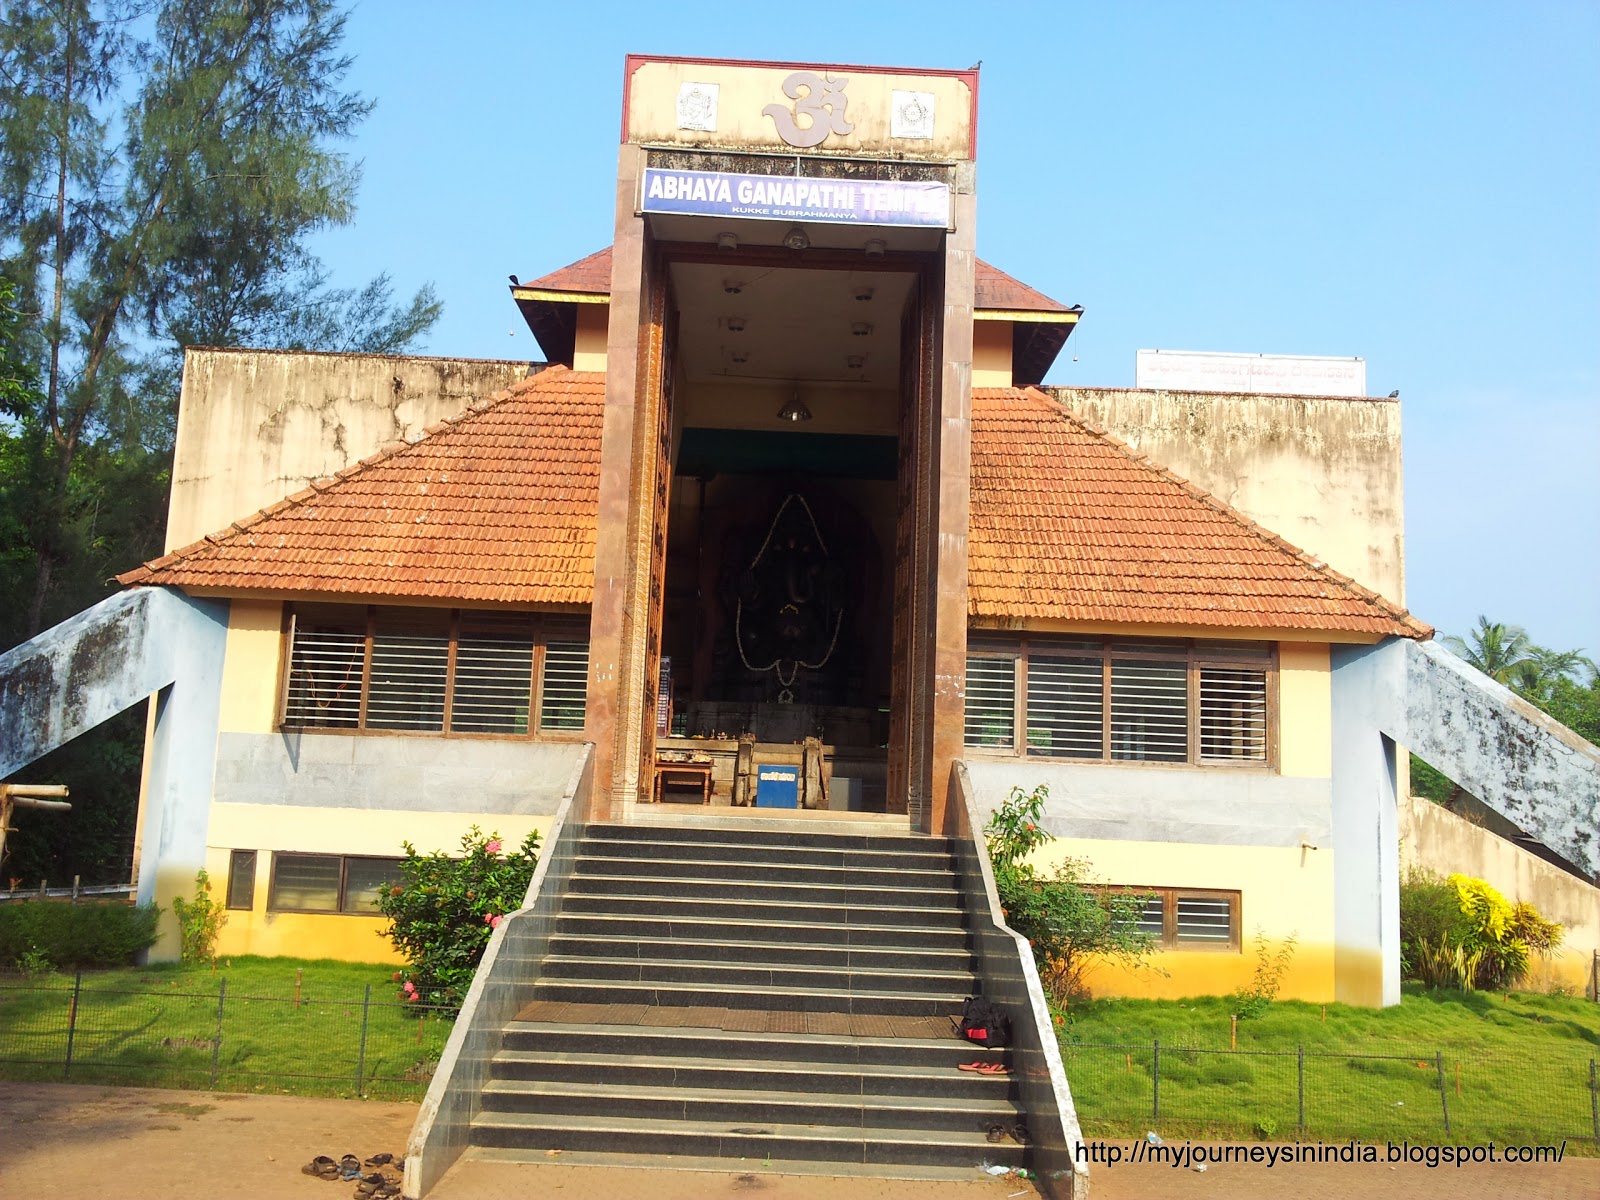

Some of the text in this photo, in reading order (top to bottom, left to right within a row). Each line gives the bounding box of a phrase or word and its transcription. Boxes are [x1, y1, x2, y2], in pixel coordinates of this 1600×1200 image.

[650, 175, 945, 214] ABHAYA GANAPATHI TEMP
[732, 206, 858, 219] KUKKE SUBRAHMANYA
